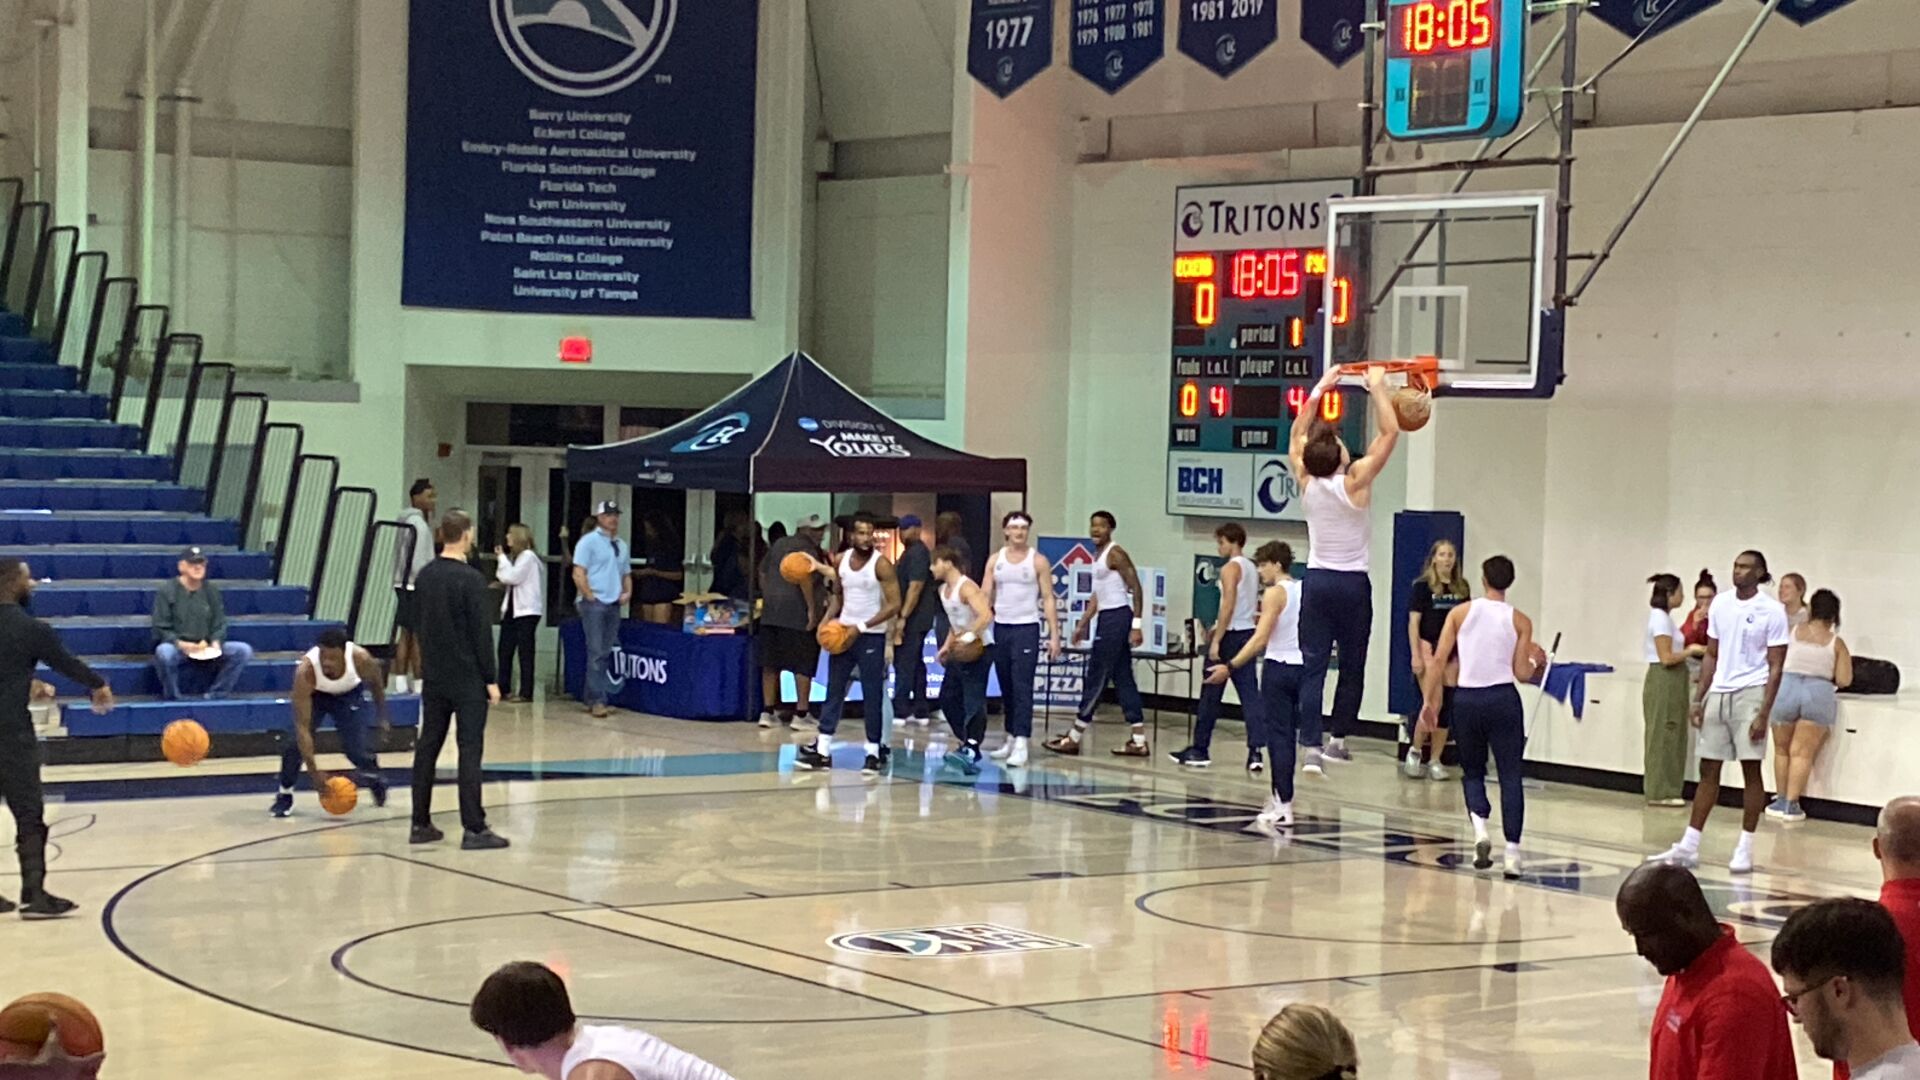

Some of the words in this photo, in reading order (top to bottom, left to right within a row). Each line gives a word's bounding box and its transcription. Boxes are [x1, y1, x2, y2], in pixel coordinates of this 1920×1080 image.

[1105, 3, 1126, 22] 1977
[1192, 0, 1224, 21] 1981
[986, 16, 1034, 49] 1977
[1077, 28, 1098, 45] 1979
[1133, 19, 1153, 39] 1981
[1404, 0, 1489, 51] 18:05
[529, 109, 563, 122] Barry
[567, 111, 631, 125] University
[533, 127, 576, 139] Eckerd
[579, 128, 625, 141] College
[461, 140, 546, 155] Embry-Riddle
[550, 145, 628, 158] Aeronautical
[632, 149, 696, 161] University
[502, 161, 546, 173] Florida
[549, 163, 606, 175] Southern
[609, 164, 656, 178] College
[540, 181, 584, 192] Florida
[588, 181, 616, 193] Tech
[529, 198, 559, 211] Lynn
[562, 199, 626, 213] University
[484, 213, 516, 225] Nova
[519, 215, 603, 228] Southeastern
[606, 218, 671, 232] University
[1209, 200, 1320, 236] TRITONS
[480, 230, 513, 243] Palm
[516, 232, 554, 244] Beach
[557, 234, 606, 246] Atlantic
[609, 235, 673, 250] University
[530, 251, 574, 262] Rollins
[577, 252, 623, 266] College
[513, 267, 546, 279] Saint
[549, 269, 572, 280] Leo
[575, 270, 640, 284] University
[1232, 252, 1299, 297] 18:05
[513, 285, 577, 300] University
[580, 288, 594, 298] of
[598, 288, 638, 301] Tampa
[1196, 282, 1214, 325] 0
[1241, 325, 1275, 346] period
[1292, 317, 1301, 347] 1
[1177, 357, 1200, 375] fouls
[1240, 357, 1275, 377] player
[1180, 383, 1198, 417] 0
[1209, 386, 1226, 416] 4
[1287, 386, 1304, 415] 4
[840, 432, 881, 442] MAKE
[1176, 428, 1196, 442] won
[1241, 430, 1268, 447] game
[809, 435, 911, 457] YOURS
[1178, 467, 1222, 494] BCH
[611, 646, 667, 684] TRITONS
